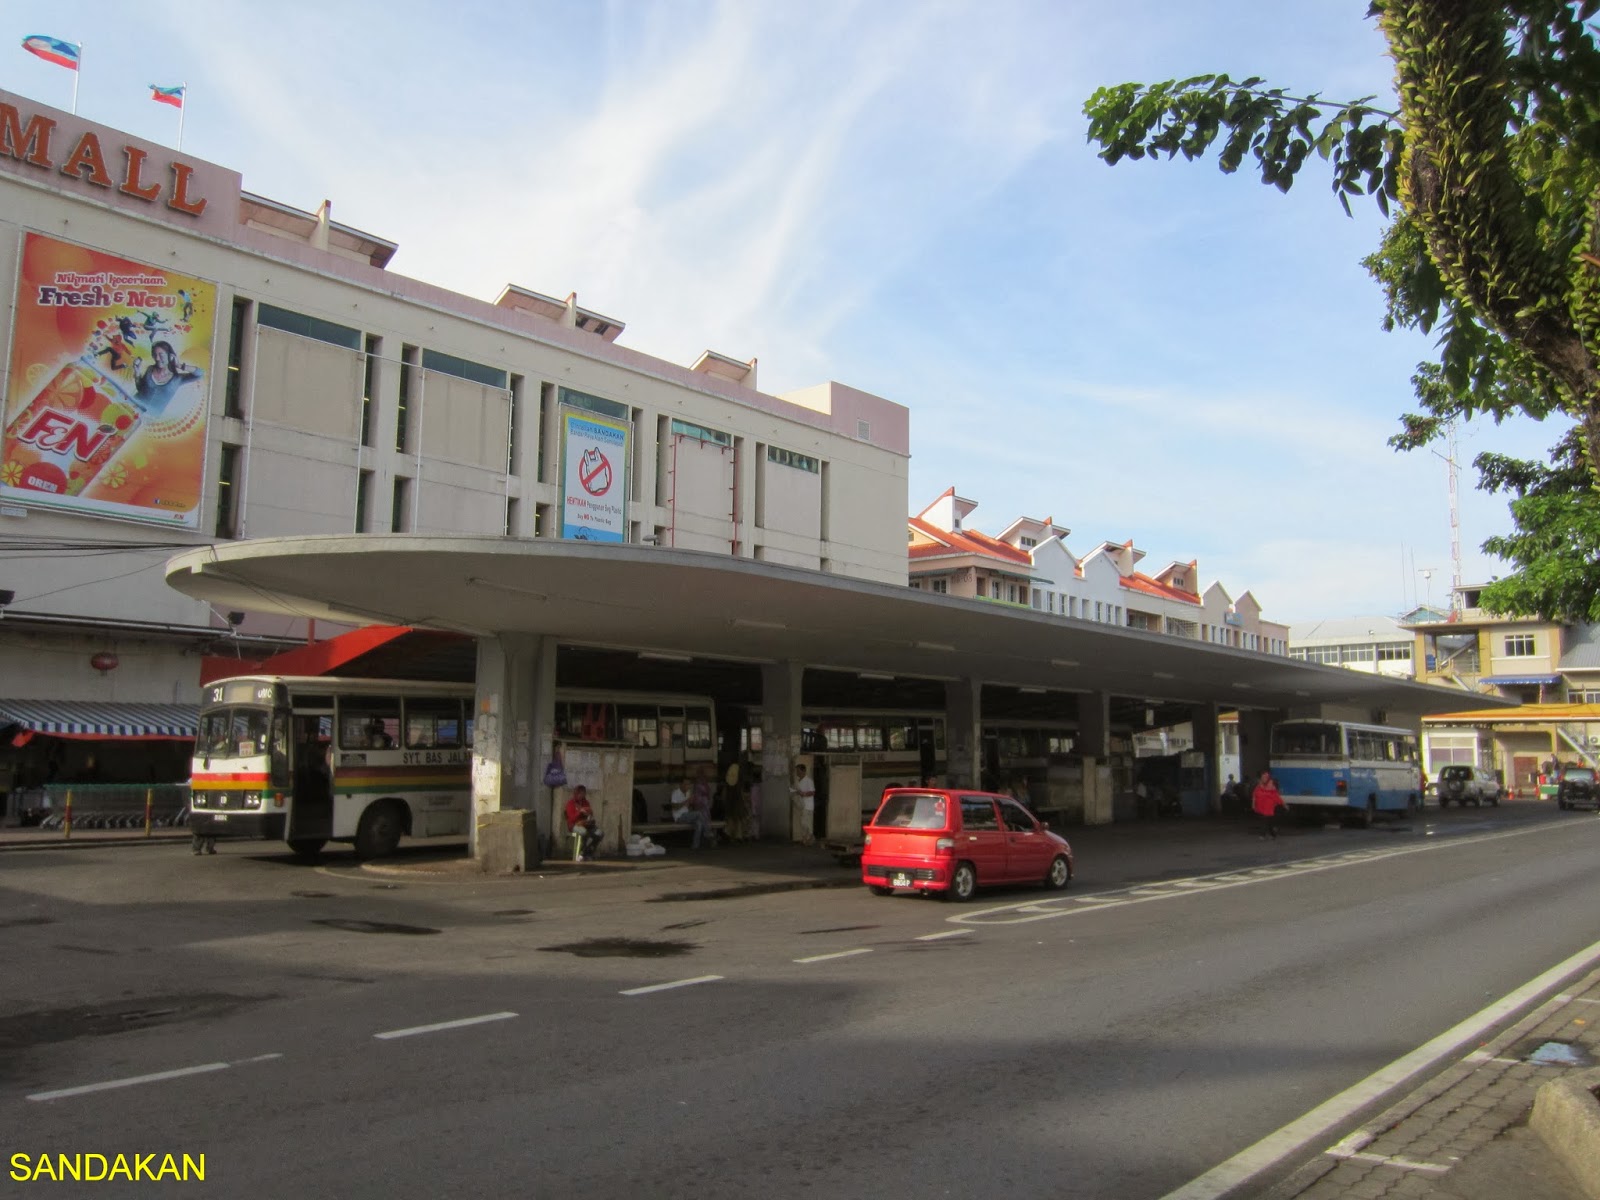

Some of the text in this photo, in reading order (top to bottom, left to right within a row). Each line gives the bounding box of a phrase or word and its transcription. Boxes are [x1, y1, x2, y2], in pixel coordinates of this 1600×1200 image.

[0, 103, 208, 216] MALL
[56, 273, 104, 286] Nikmati
[39, 286, 177, 307] Fresh & New
[20, 408, 110, 460] F&N
[28, 476, 58, 492] OREN
[213, 687, 223, 702] 31
[425, 751, 442, 763] BAS
